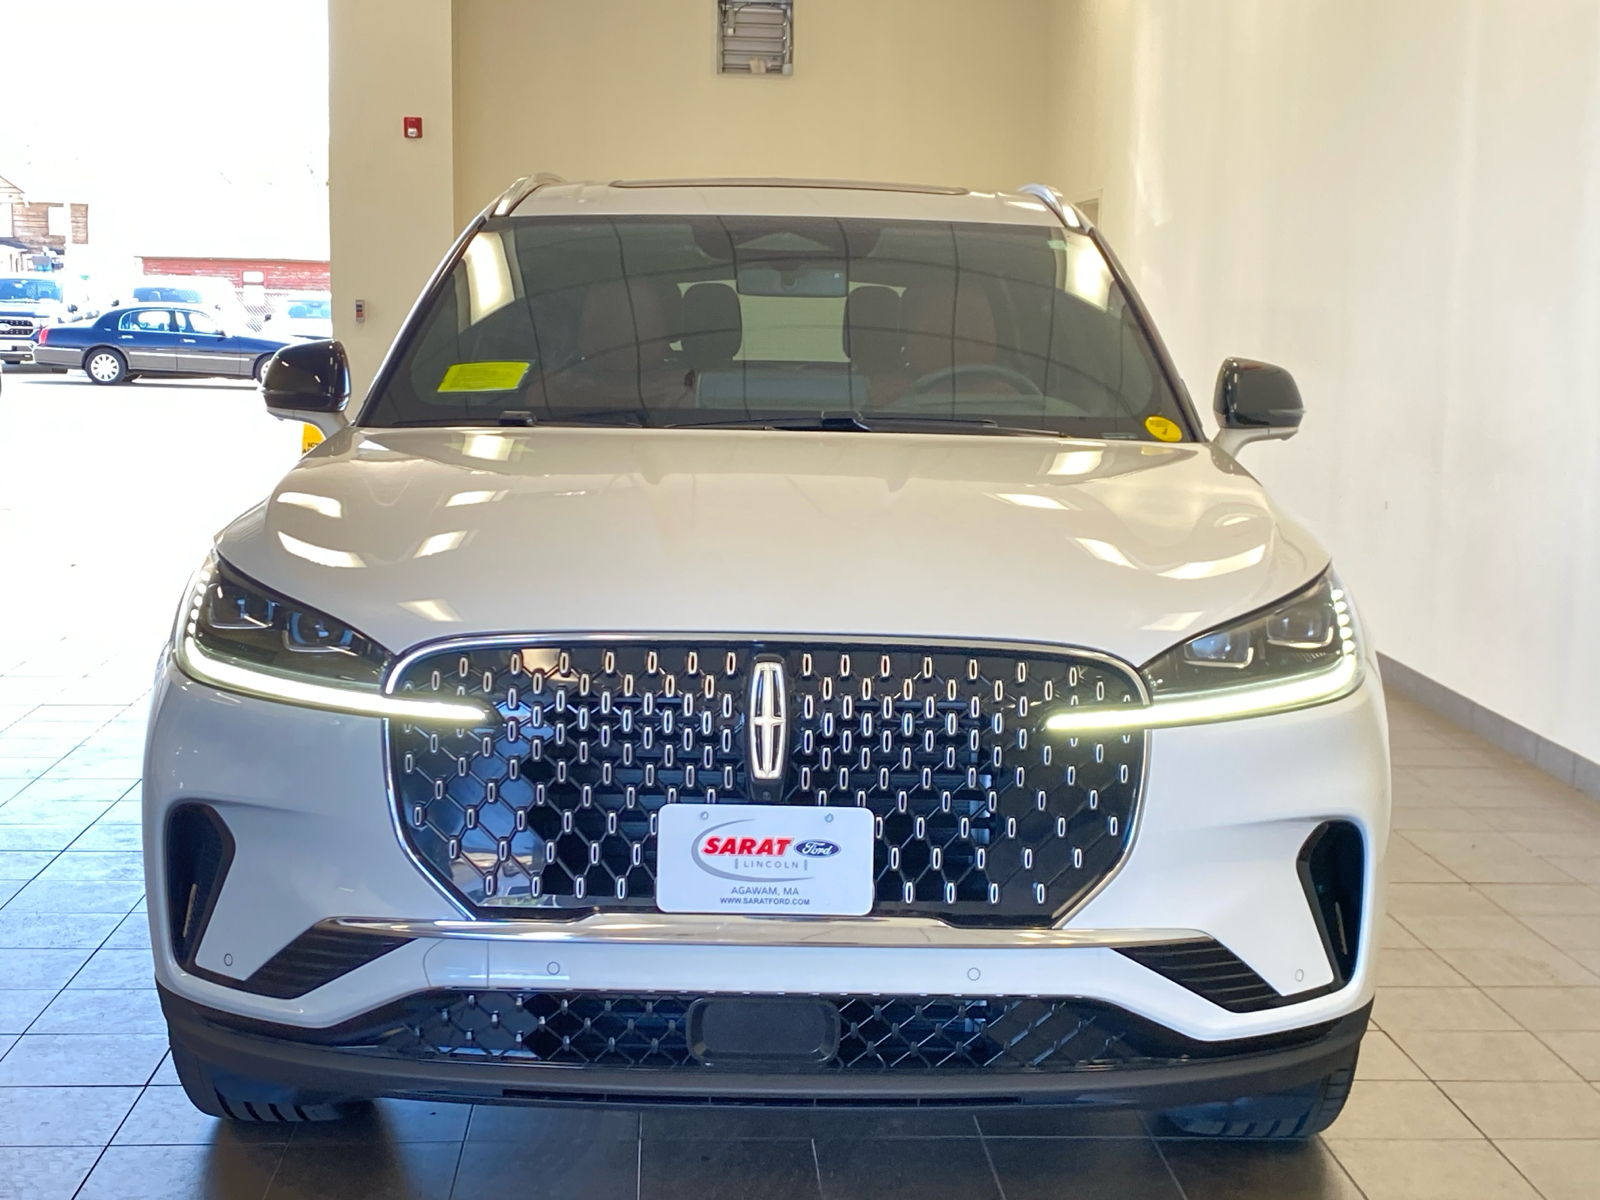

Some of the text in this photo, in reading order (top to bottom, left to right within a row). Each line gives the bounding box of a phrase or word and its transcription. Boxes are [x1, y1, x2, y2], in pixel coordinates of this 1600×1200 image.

[702, 837, 833, 857] SARAT Ford
[743, 860, 799, 869] LINCOLN
[731, 886, 799, 896] AGAWAM, MA
[720, 897, 810, 906] WWW.SARATFORD.COM
